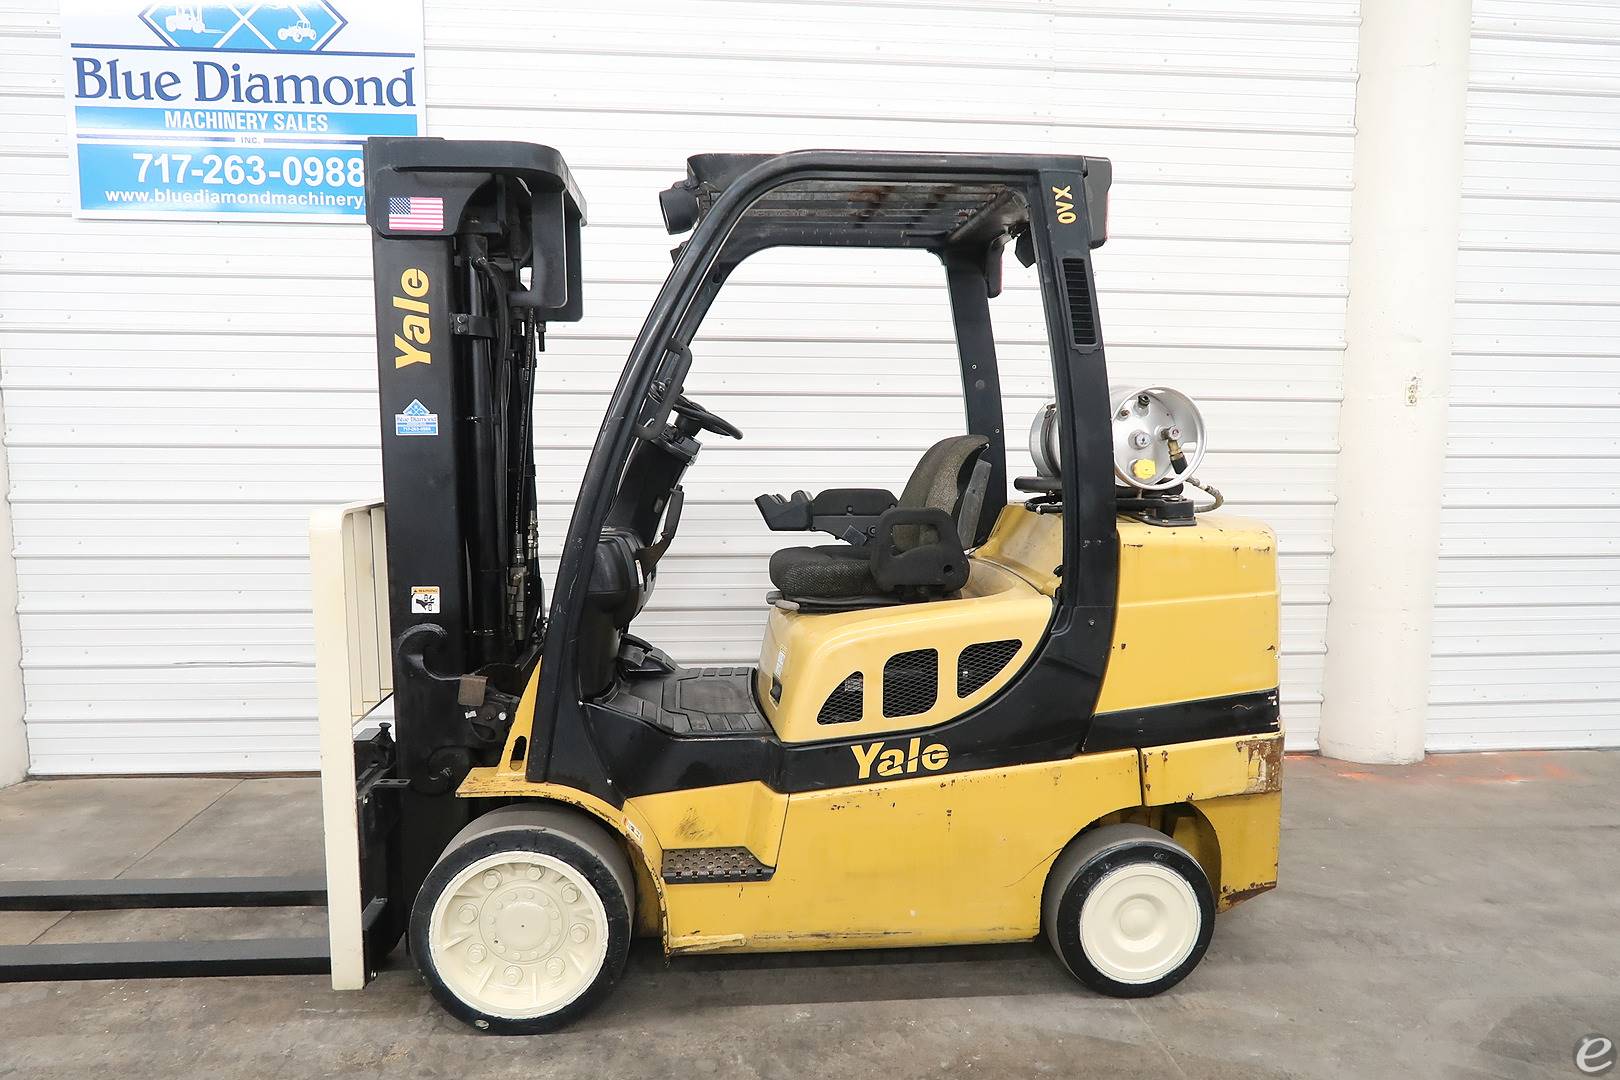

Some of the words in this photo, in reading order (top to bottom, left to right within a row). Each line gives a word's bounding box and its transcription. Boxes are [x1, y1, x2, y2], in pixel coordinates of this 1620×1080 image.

[72, 56, 182, 102] Blue
[192, 60, 417, 107] Diamond
[164, 110, 269, 130] MACHINERY
[273, 113, 329, 132] SALES
[240, 136, 261, 144] INC.
[132, 152, 365, 188] 717-263-0988
[393, 267, 432, 369] Yale
[850, 737, 950, 780] Yale
